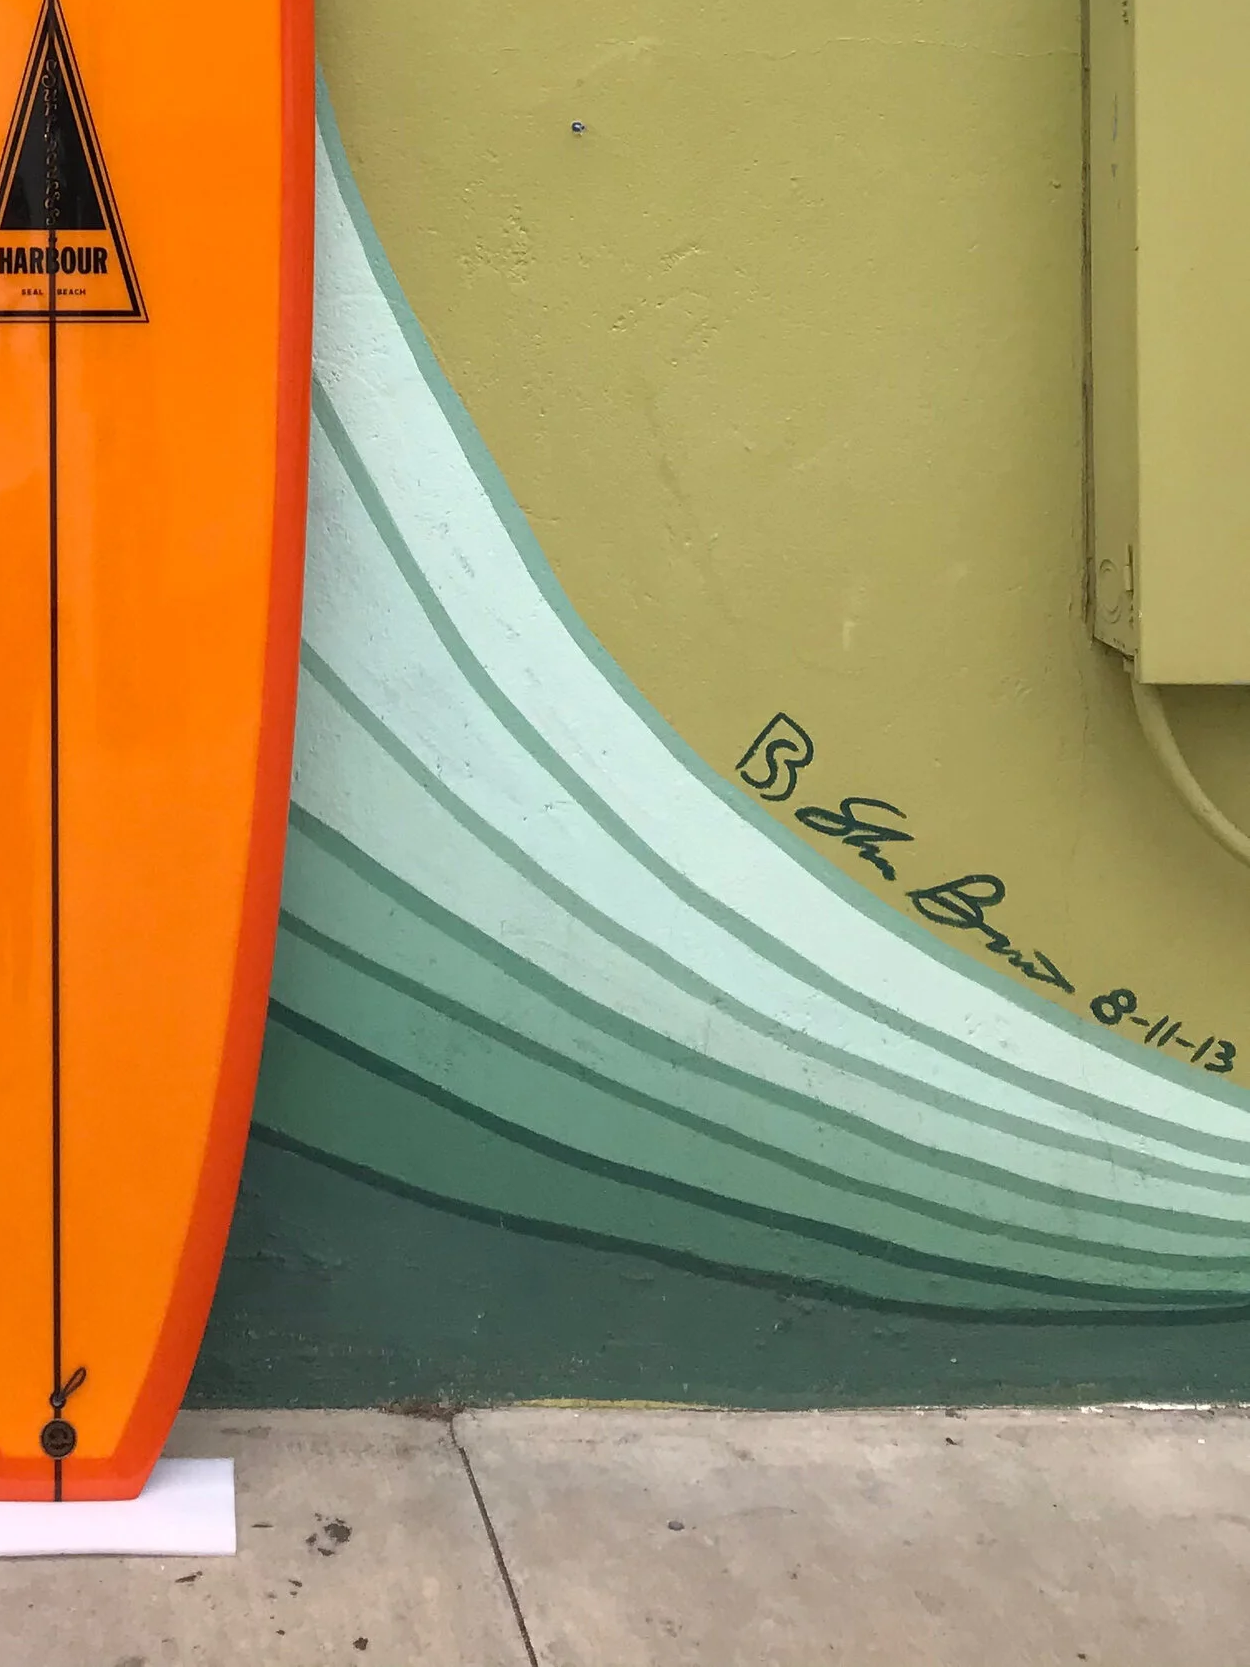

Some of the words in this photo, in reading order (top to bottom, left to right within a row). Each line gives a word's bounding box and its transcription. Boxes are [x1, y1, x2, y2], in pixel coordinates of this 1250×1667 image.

[21, 288, 44, 296] SEAL
[56, 288, 86, 296] BEACH
[1089, 988, 1238, 1074] 8-11-13
